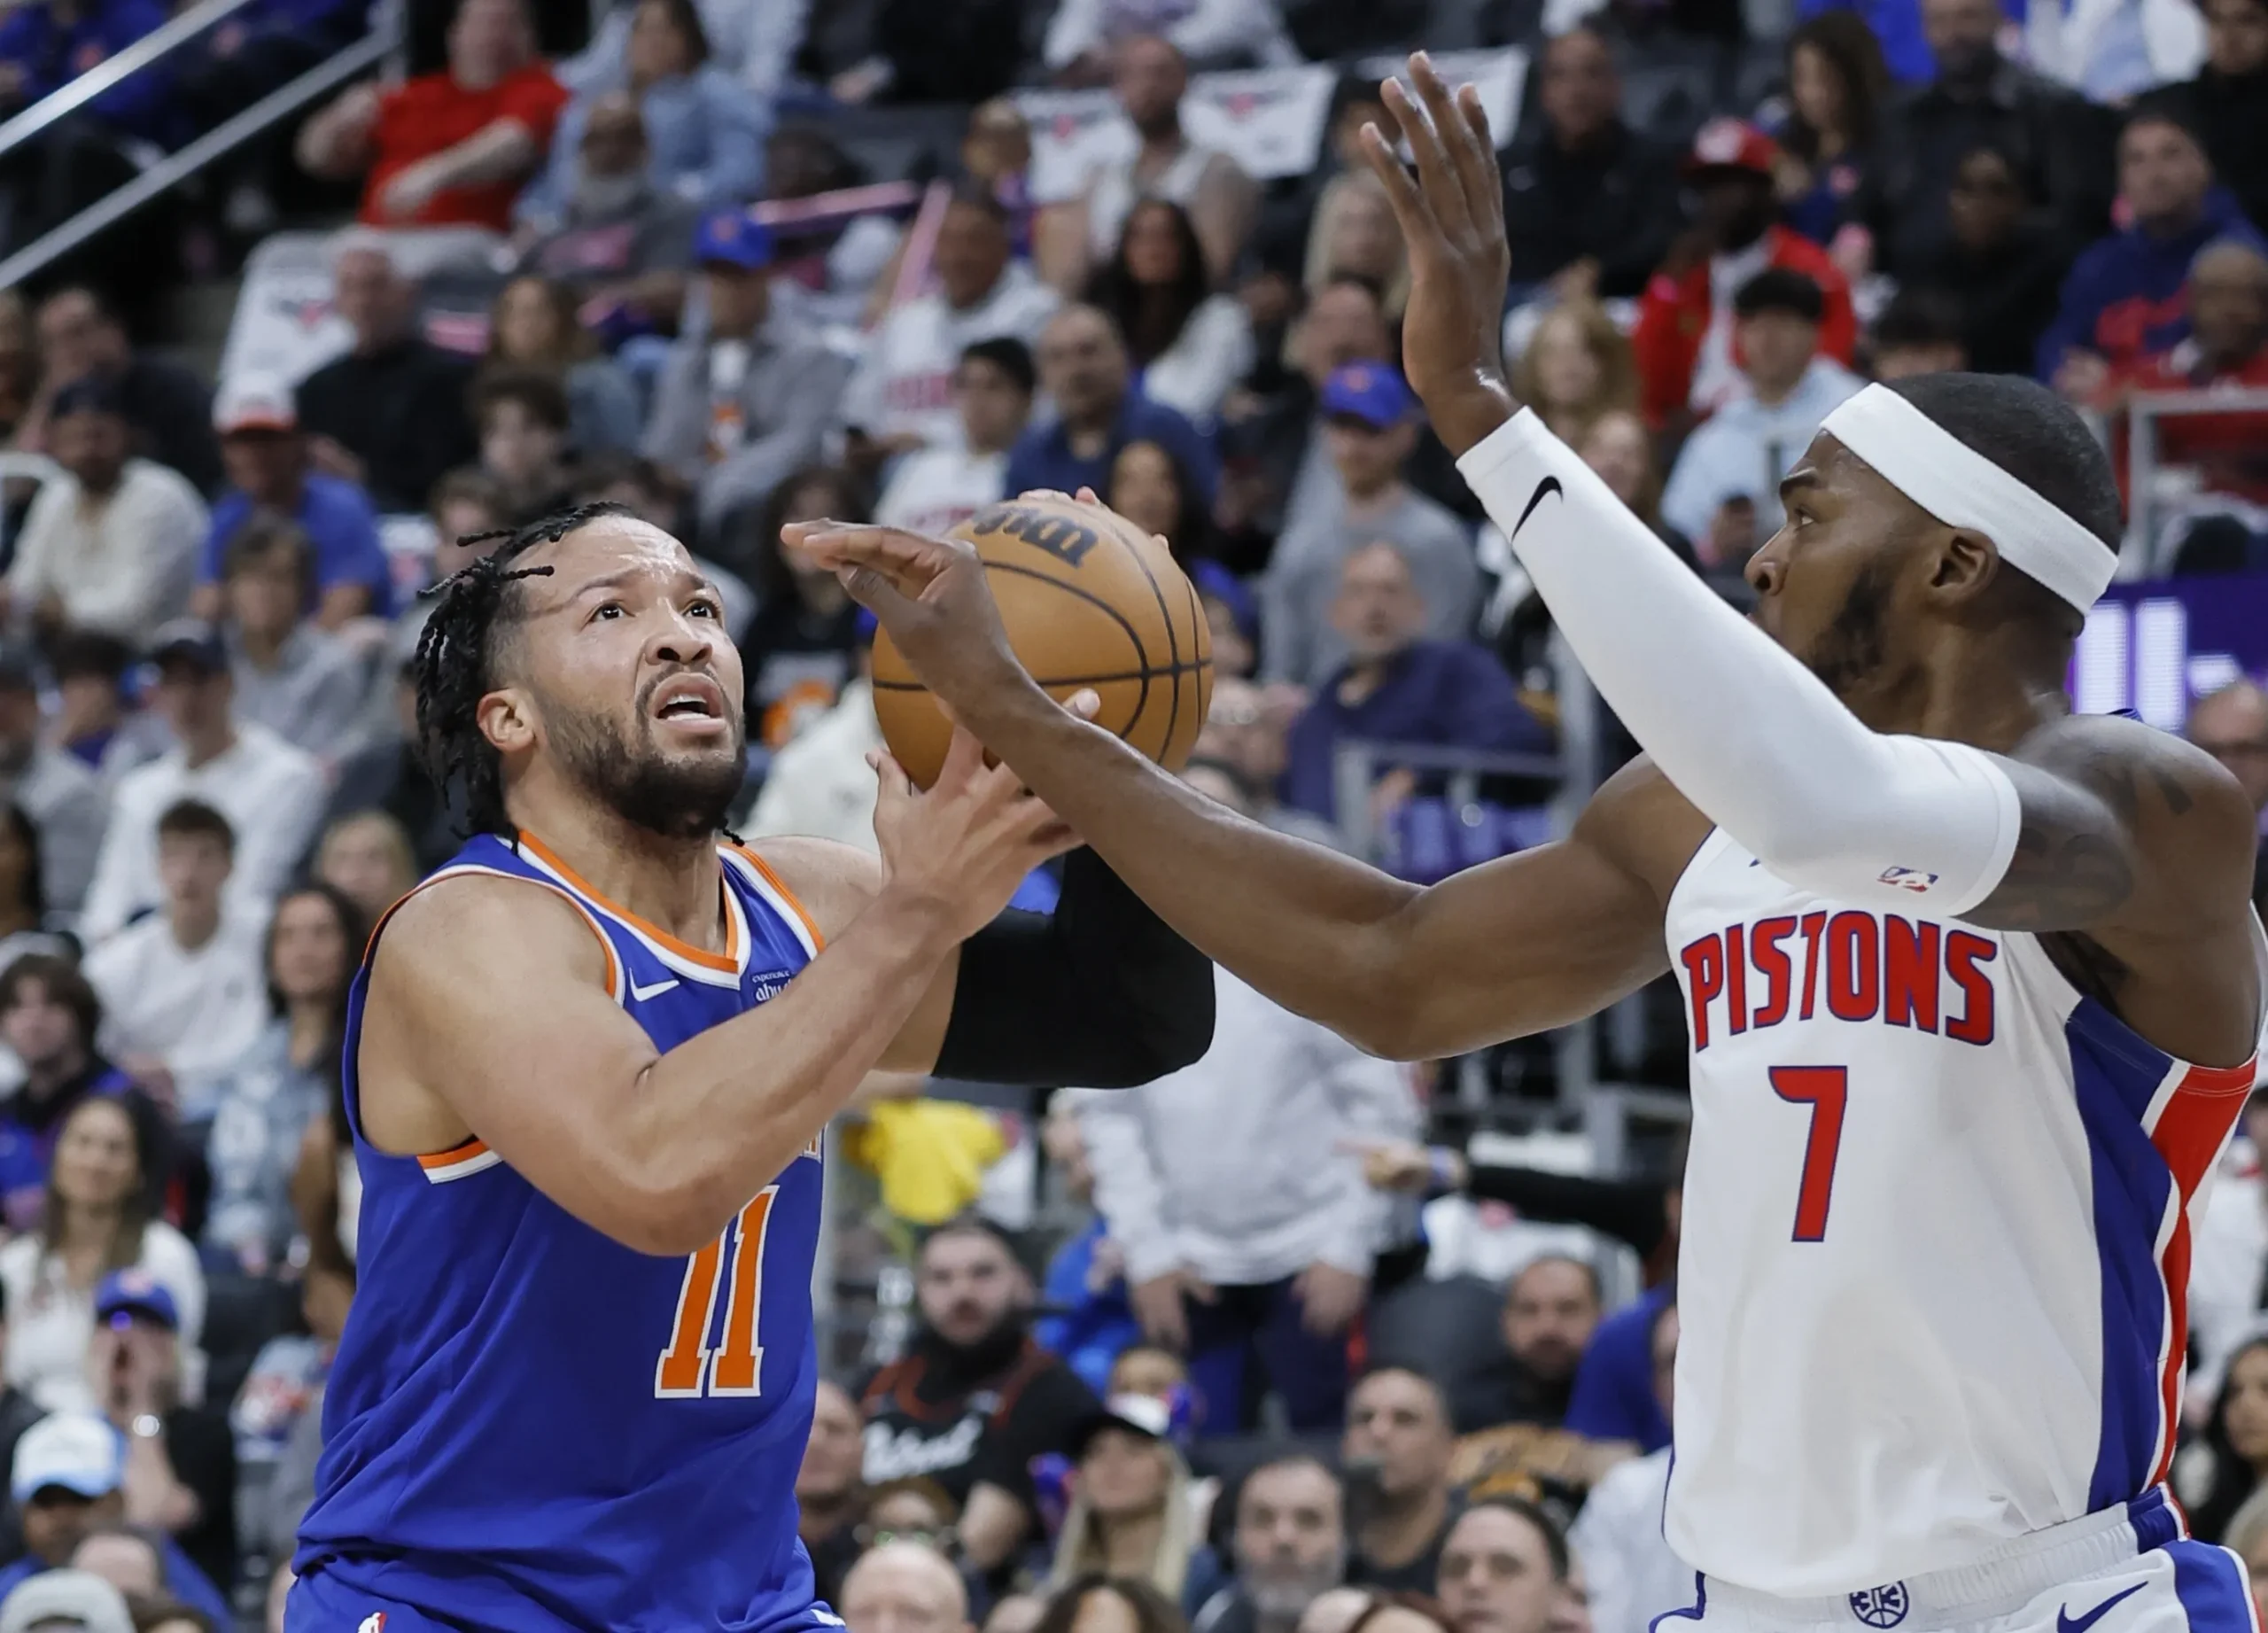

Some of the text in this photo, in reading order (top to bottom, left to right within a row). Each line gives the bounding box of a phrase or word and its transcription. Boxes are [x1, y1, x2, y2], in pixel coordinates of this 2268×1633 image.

[1681, 909, 1997, 1054] PISTONS
[1767, 1065, 1848, 1242] 7
[654, 1185, 781, 1398] 11
